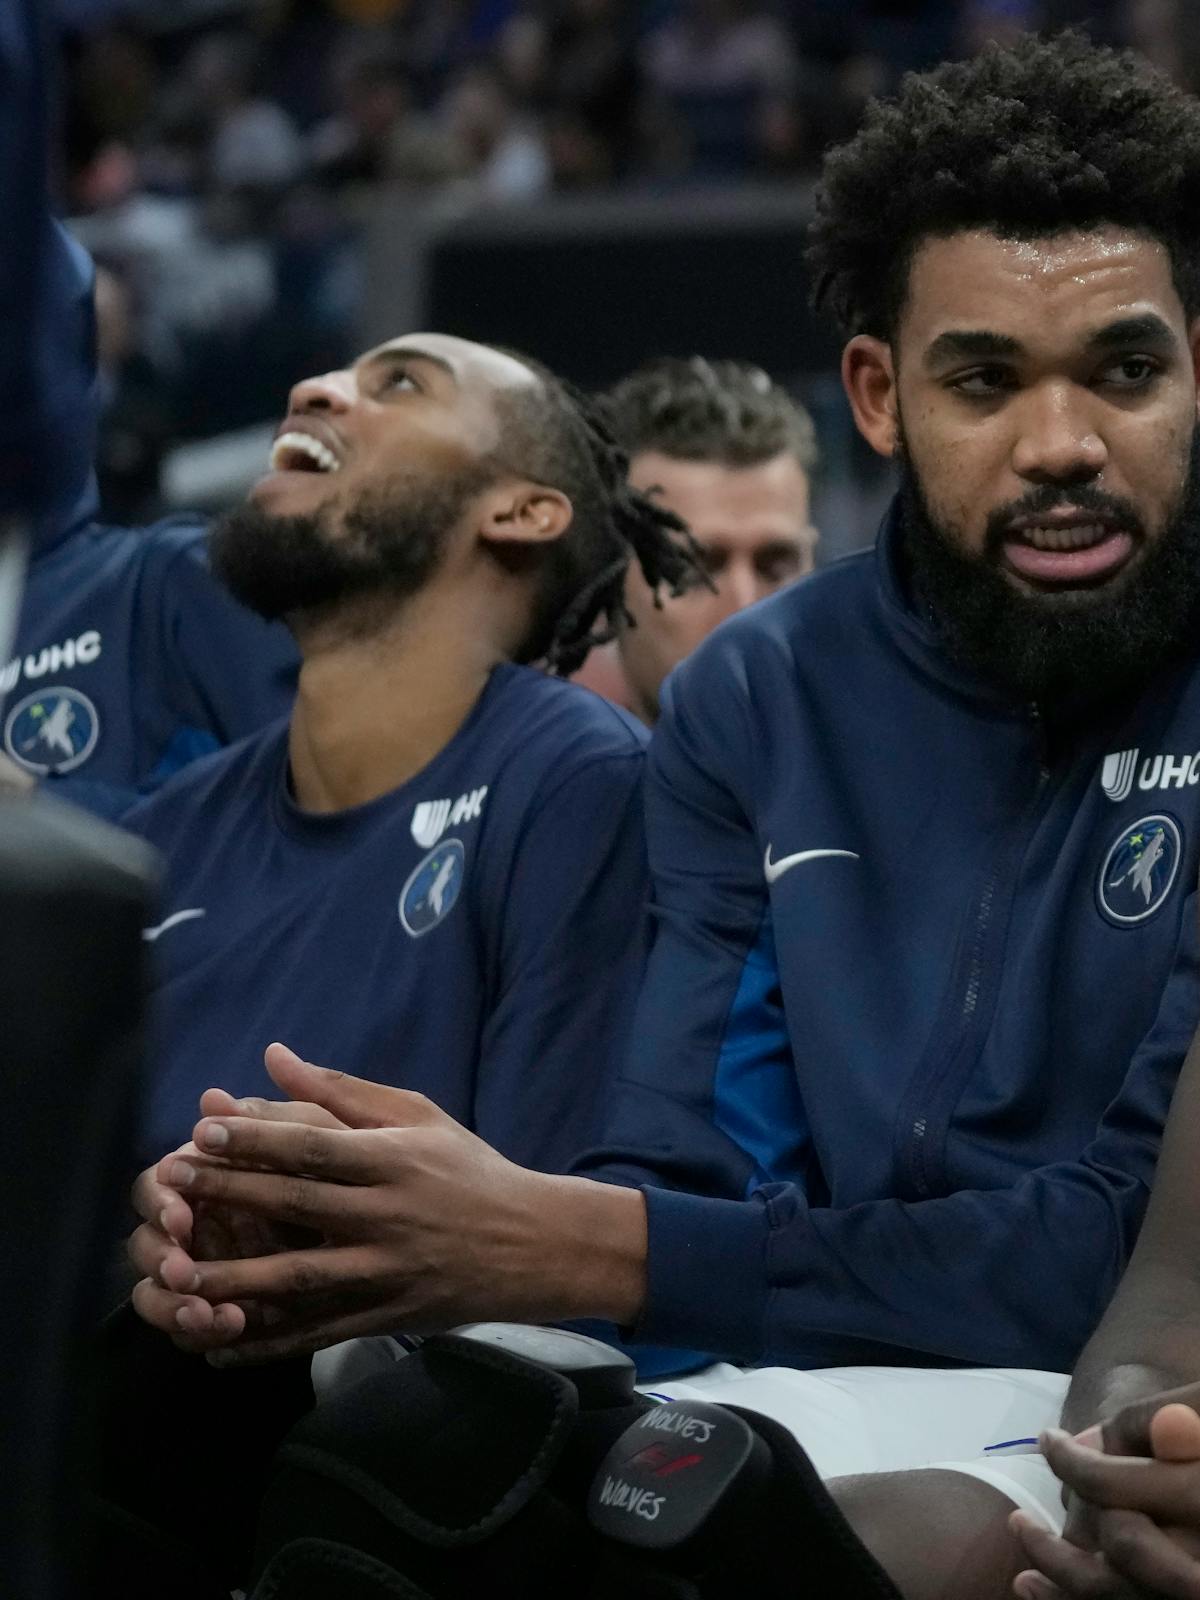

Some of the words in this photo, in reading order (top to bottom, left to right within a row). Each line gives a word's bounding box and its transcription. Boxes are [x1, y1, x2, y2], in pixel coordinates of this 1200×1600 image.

[23, 630, 101, 679] UHC
[640, 1407, 717, 1444] WOLVES
[600, 1475, 667, 1521] WOLVES
